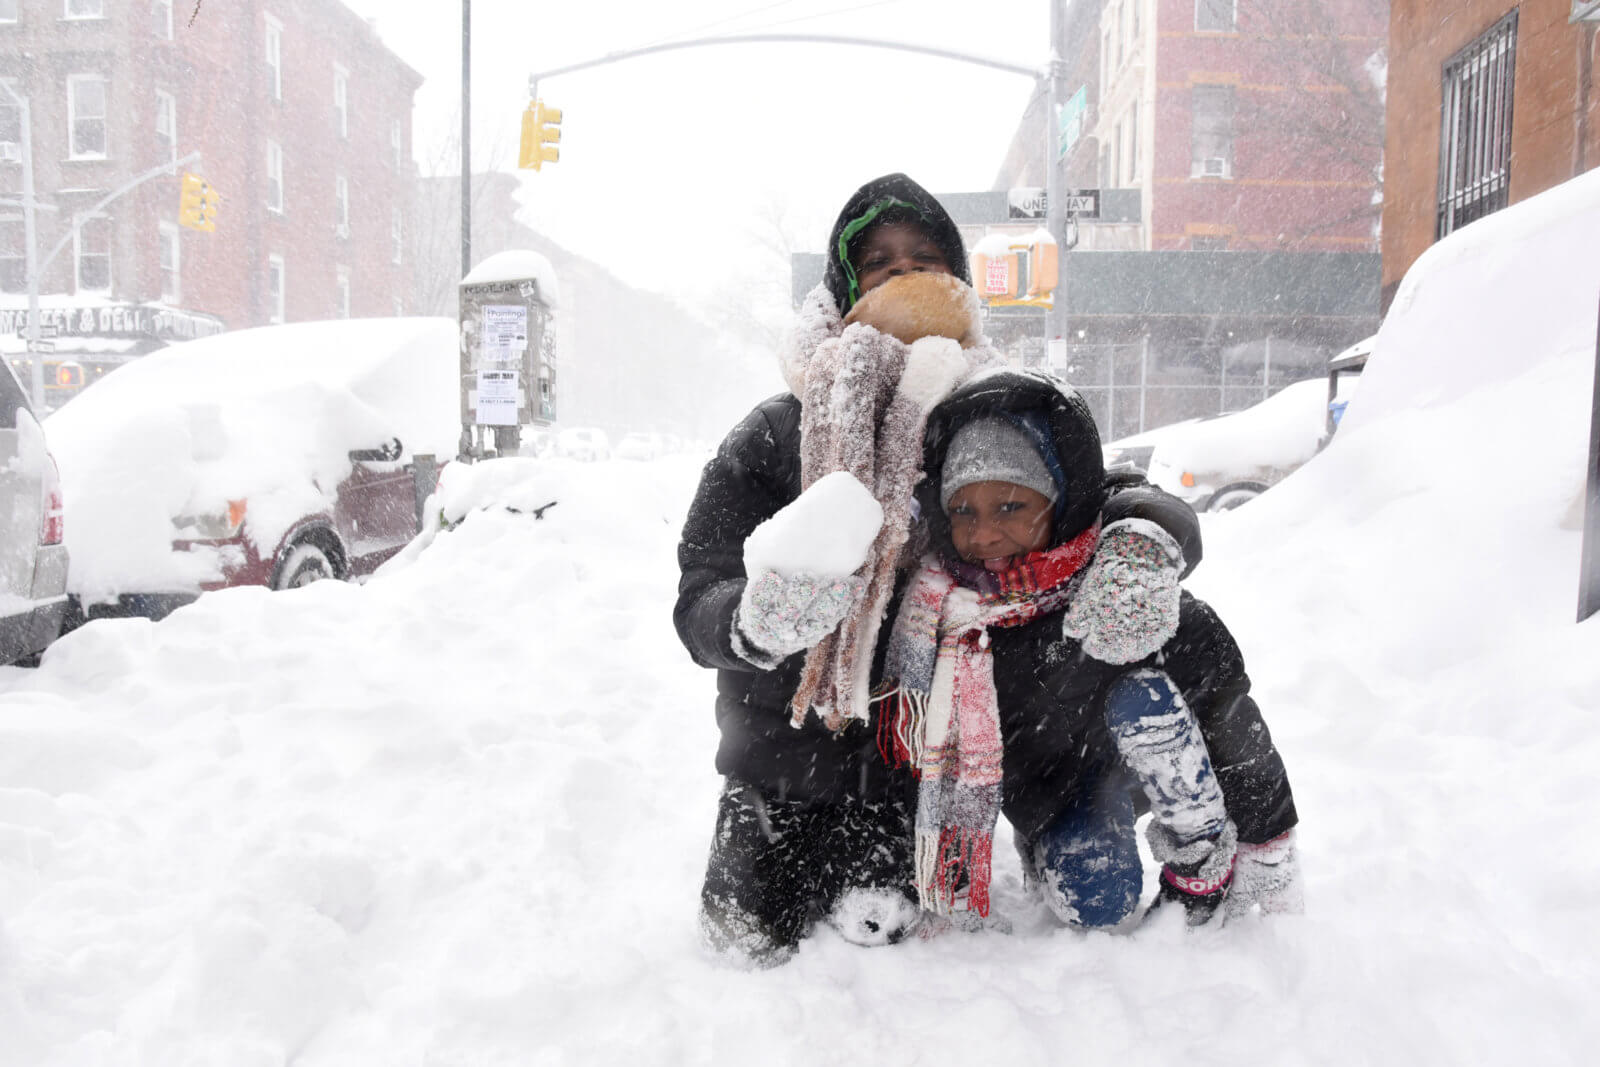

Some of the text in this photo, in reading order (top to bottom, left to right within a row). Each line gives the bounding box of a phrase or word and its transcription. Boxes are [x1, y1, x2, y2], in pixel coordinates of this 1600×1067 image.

[1022, 198, 1089, 210] ONE AY
[0, 309, 77, 334] MAKET
[80, 307, 96, 333] &
[99, 305, 140, 332] DELI
